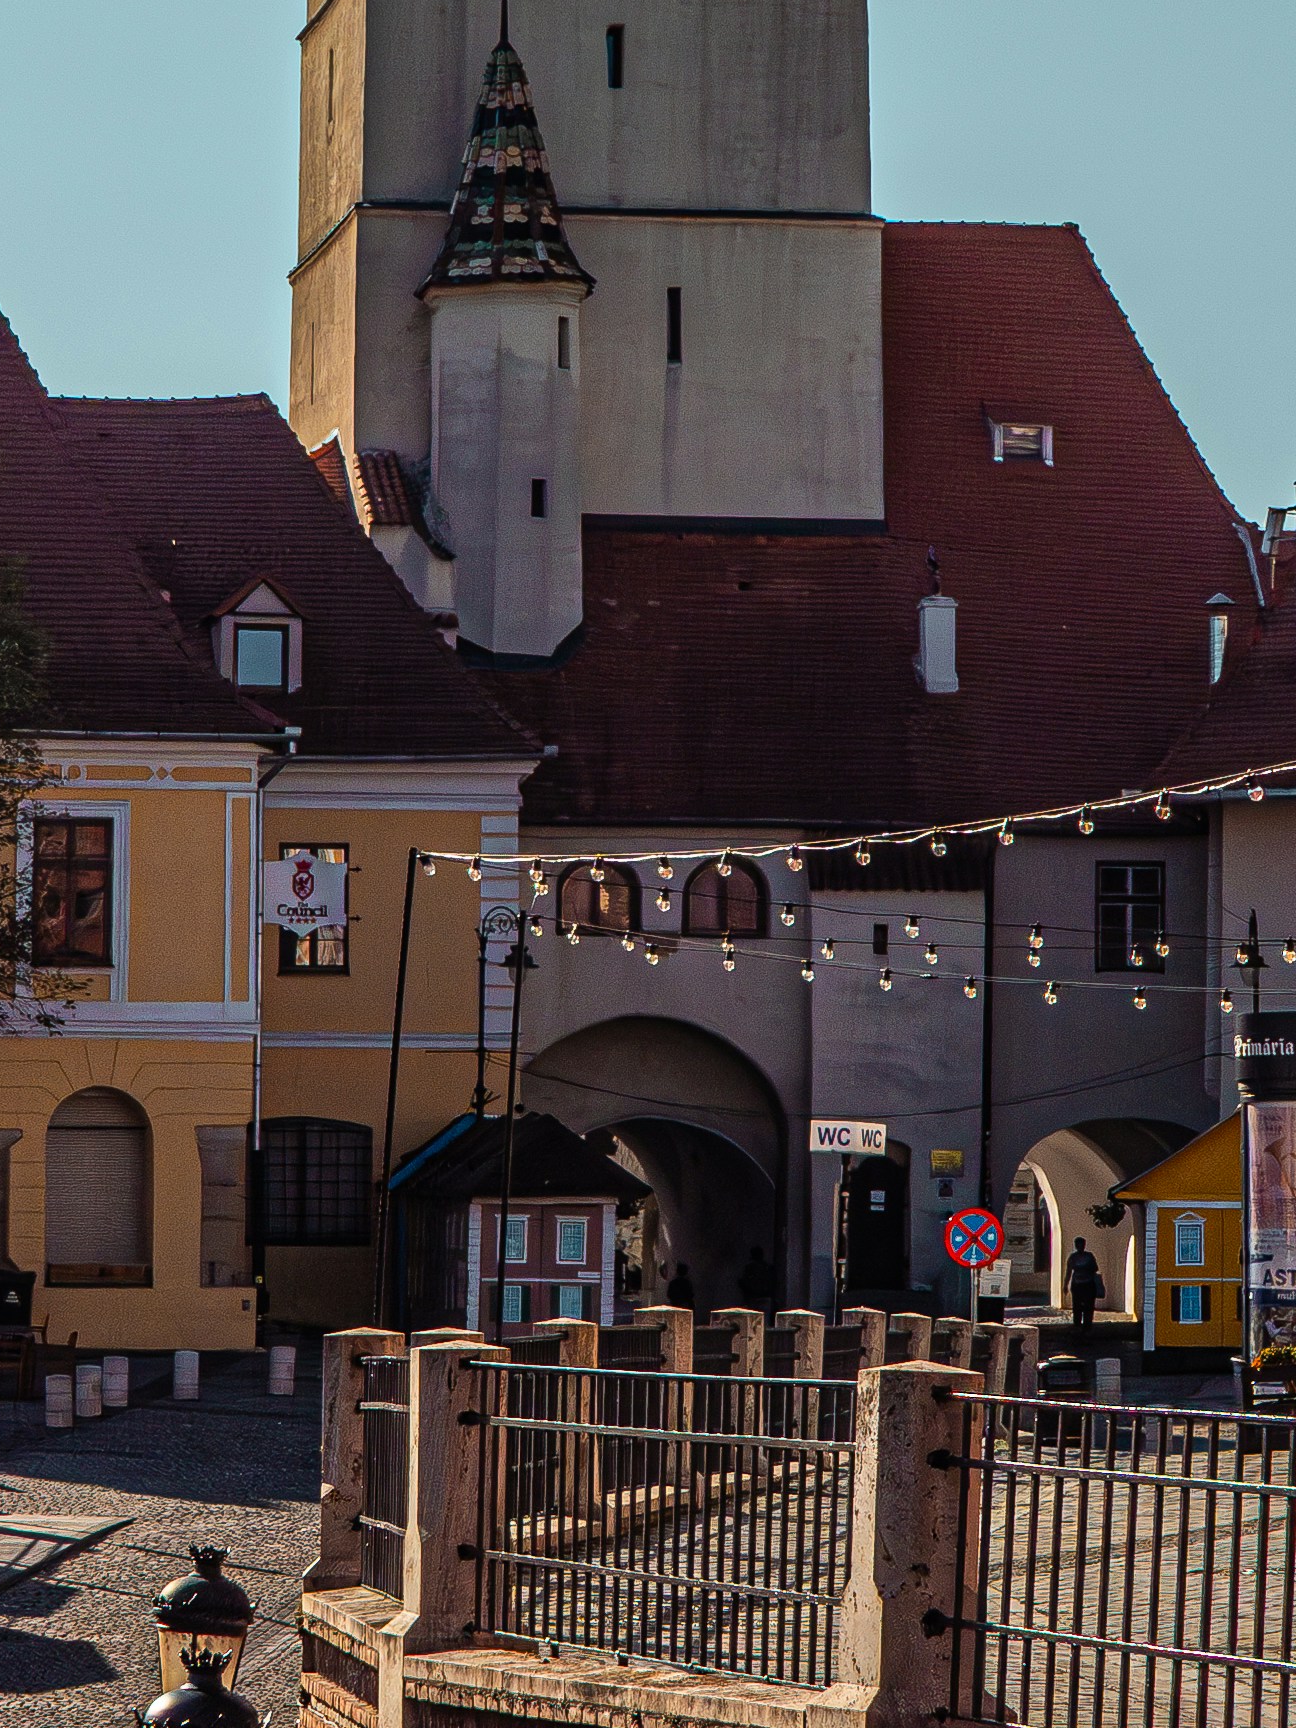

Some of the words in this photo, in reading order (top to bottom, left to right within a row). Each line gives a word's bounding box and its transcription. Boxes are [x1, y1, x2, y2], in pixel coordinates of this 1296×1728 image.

[277, 904, 328, 917] Council
[817, 1127, 851, 1146] WC
[861, 1128, 882, 1148] WC
